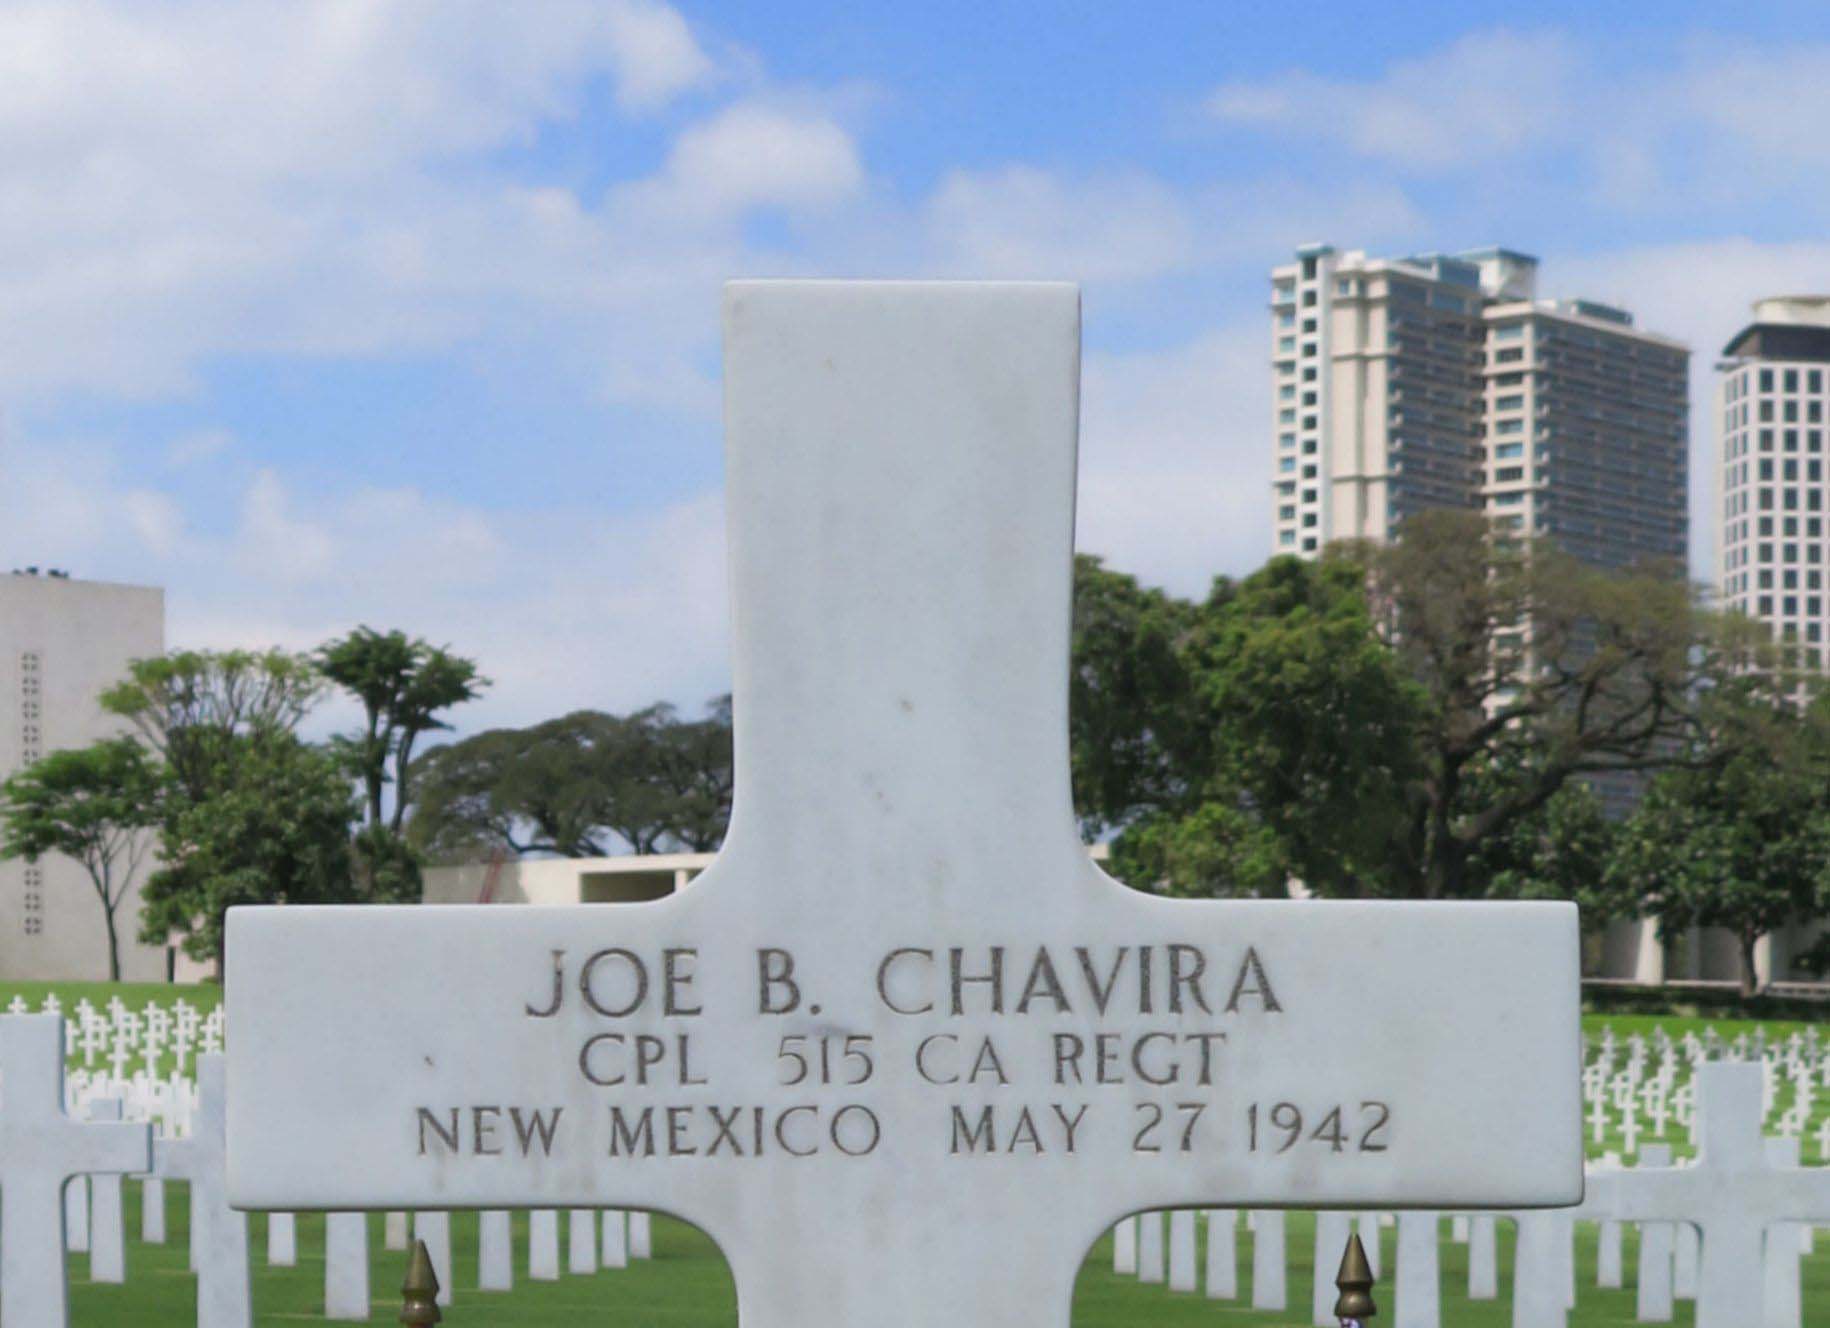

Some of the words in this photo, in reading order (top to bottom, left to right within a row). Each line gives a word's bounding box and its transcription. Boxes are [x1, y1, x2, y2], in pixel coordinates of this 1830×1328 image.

[525, 947, 703, 1018] JOE
[756, 947, 822, 1016] B.
[876, 943, 1284, 1017] CHAVIRA
[578, 1032, 709, 1086] CPL
[778, 1034, 874, 1086] 515
[915, 1032, 1009, 1085] CA
[1052, 1030, 1228, 1087] REGT
[416, 1105, 565, 1157] NEW
[607, 1103, 882, 1157] MEXICO
[949, 1104, 1089, 1155] MAY
[1132, 1102, 1207, 1154] 27
[1247, 1102, 1390, 1154] 1942
